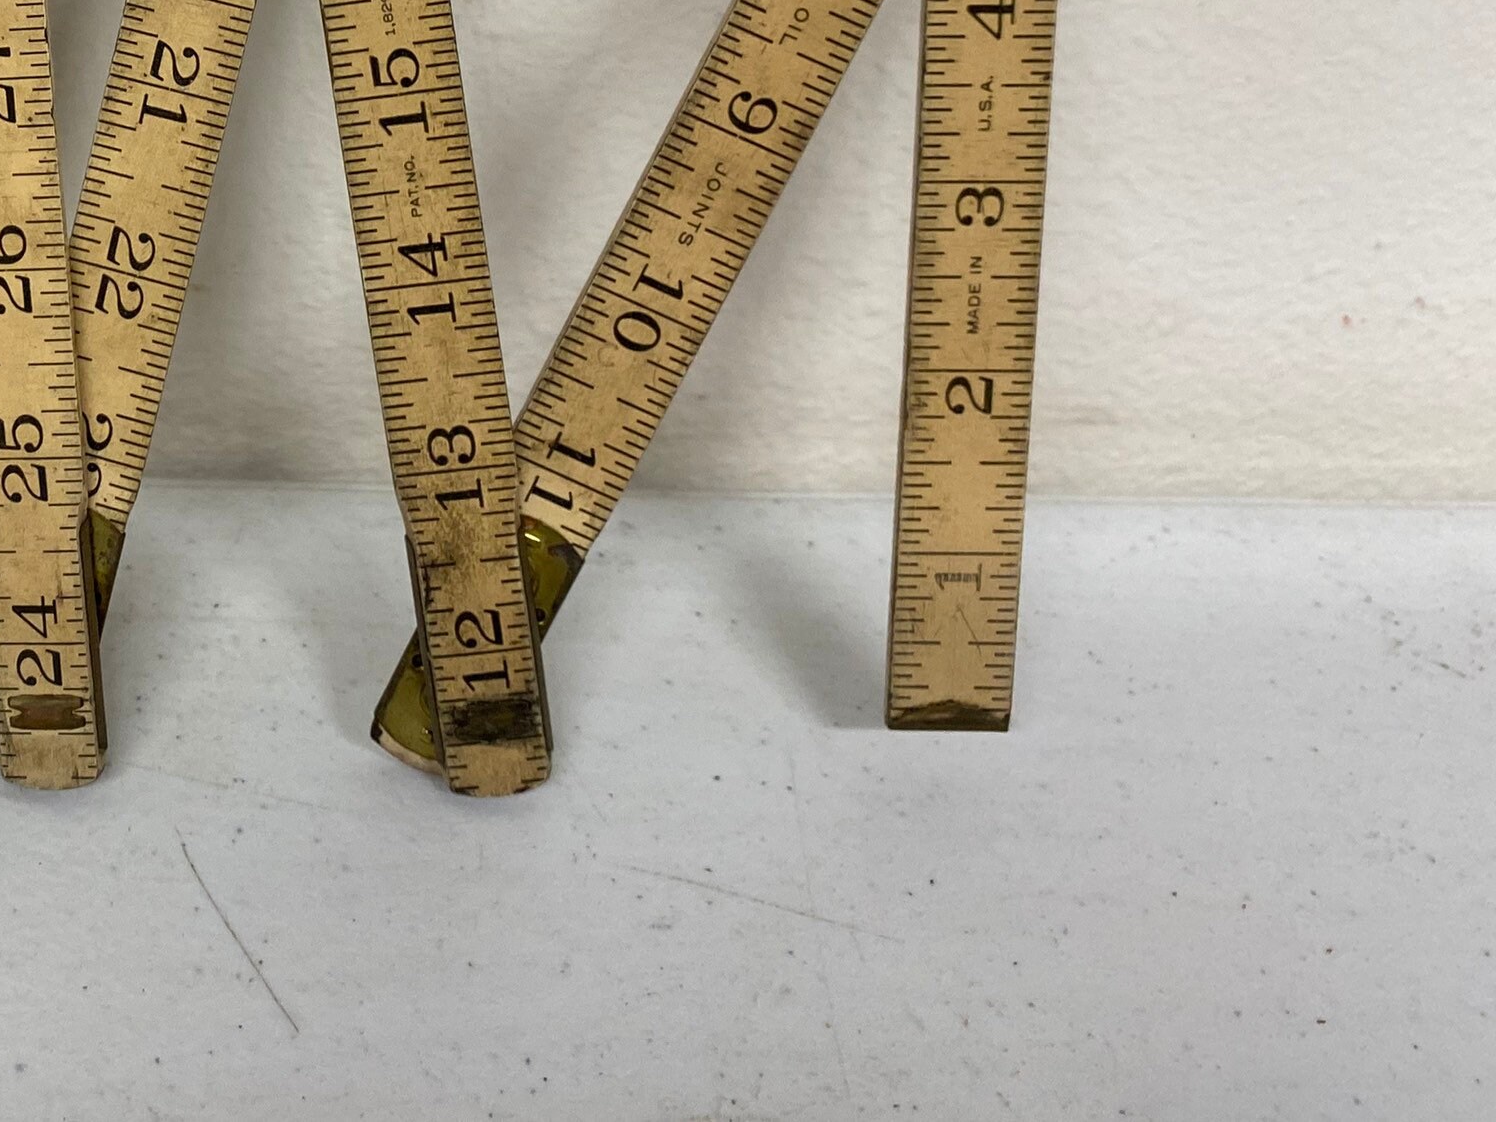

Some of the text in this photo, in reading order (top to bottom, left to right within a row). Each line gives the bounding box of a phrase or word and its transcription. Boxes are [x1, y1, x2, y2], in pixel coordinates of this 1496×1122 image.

[778, 7, 809, 45] OIL
[138, 39, 200, 125] 21
[369, 47, 430, 137] 15
[727, 90, 778, 135] 9
[977, 75, 995, 132] U.S.A.
[677, 161, 728, 248] JOINTS
[955, 186, 1005, 227] 3
[94, 226, 155, 320] 22
[397, 232, 457, 326] 14
[612, 263, 685, 353] 10
[966, 256, 983, 335] MADE IN
[945, 375, 994, 415] 2
[427, 424, 484, 512] 13
[524, 431, 596, 512] 11
[934, 563, 982, 592] 1
[12, 595, 62, 687] 24
[454, 608, 511, 693] 12
